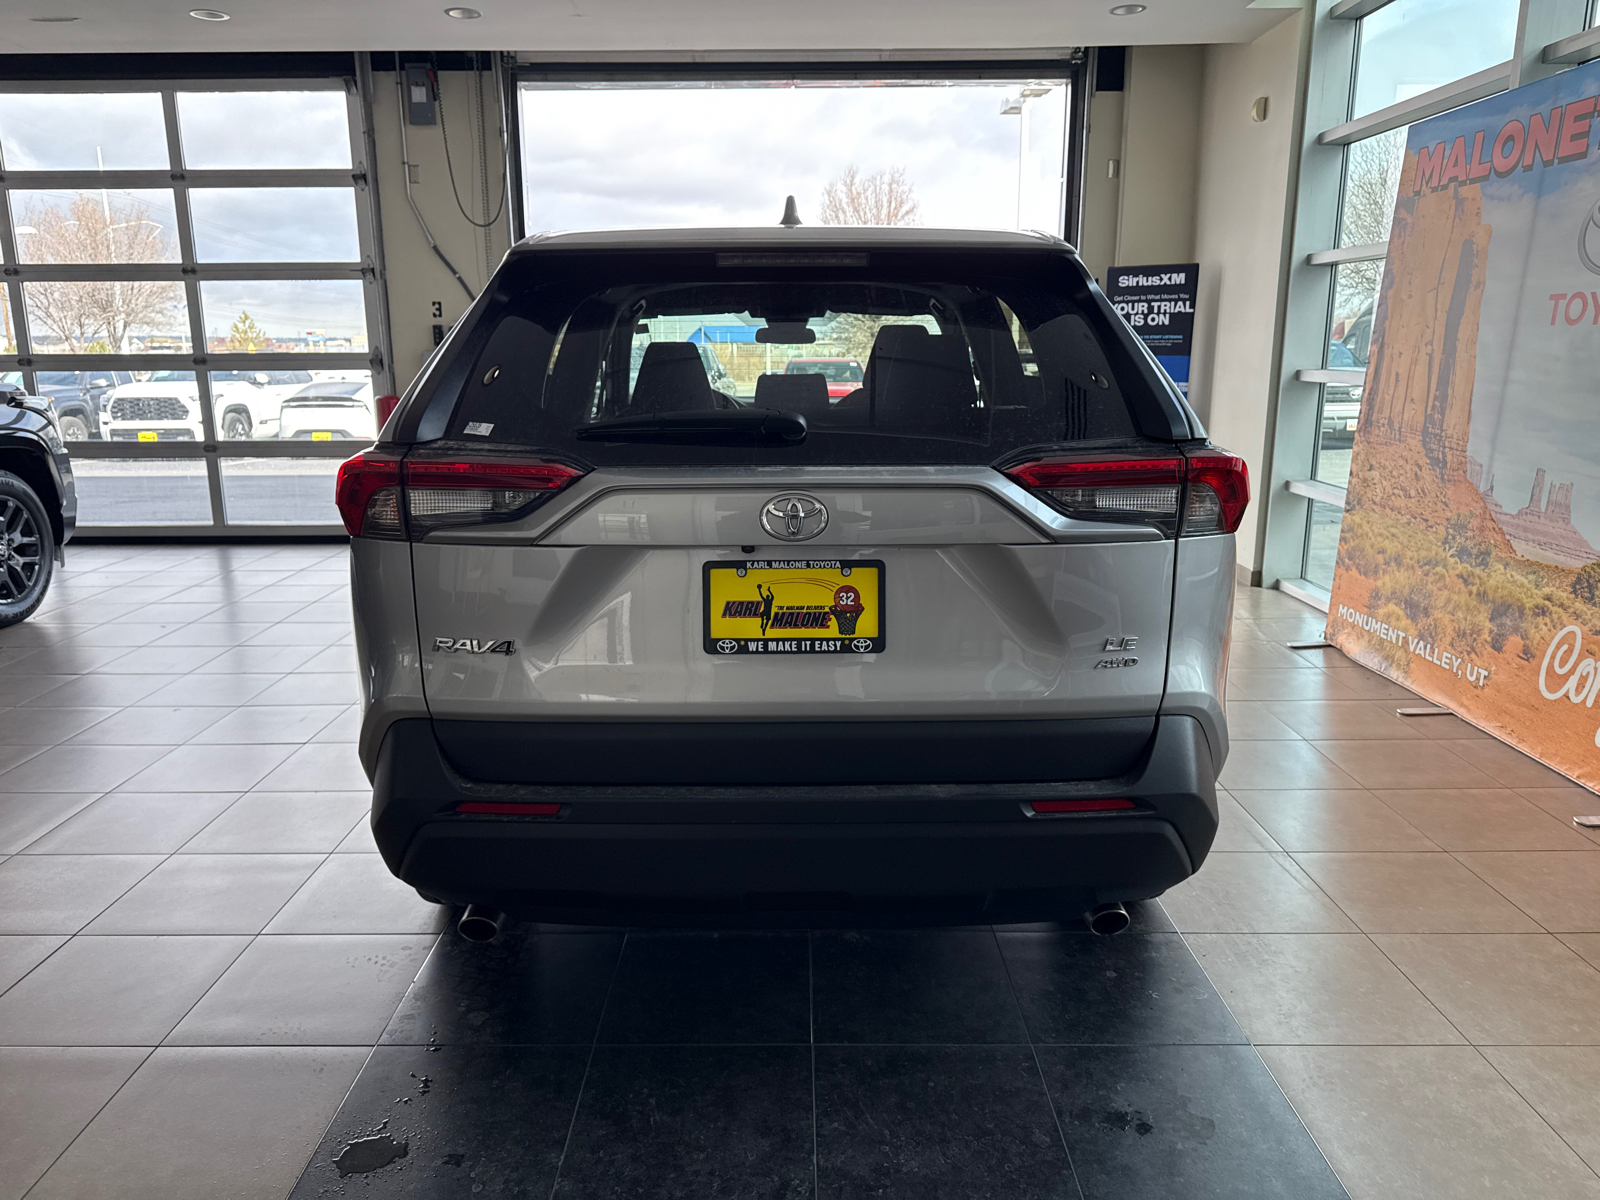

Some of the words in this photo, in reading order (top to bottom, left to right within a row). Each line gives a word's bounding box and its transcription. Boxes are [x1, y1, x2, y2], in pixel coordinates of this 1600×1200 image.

[1413, 94, 1600, 196] MALONE
[1118, 273, 1186, 287] SiriusXM
[432, 301, 443, 318] 3
[1151, 301, 1194, 314] TRIAL
[1130, 314, 1145, 326] IS
[1147, 313, 1170, 326] ON
[746, 561, 770, 569] KARL
[772, 561, 807, 569] MALONE
[808, 561, 841, 569] TOYOTA
[839, 592, 855, 605] 32
[721, 600, 764, 619] KARL
[769, 611, 832, 629] MALONE
[432, 636, 517, 656] RAV4
[748, 641, 764, 651] WE
[768, 641, 798, 651] MAKE
[801, 641, 811, 651] IT
[815, 641, 842, 651] EASY
[1103, 636, 1139, 651] LE
[1337, 603, 1406, 646] MONUMENT
[1408, 635, 1463, 679] VALLEY,
[1466, 664, 1489, 687] UT
[1094, 656, 1139, 669] AWD
